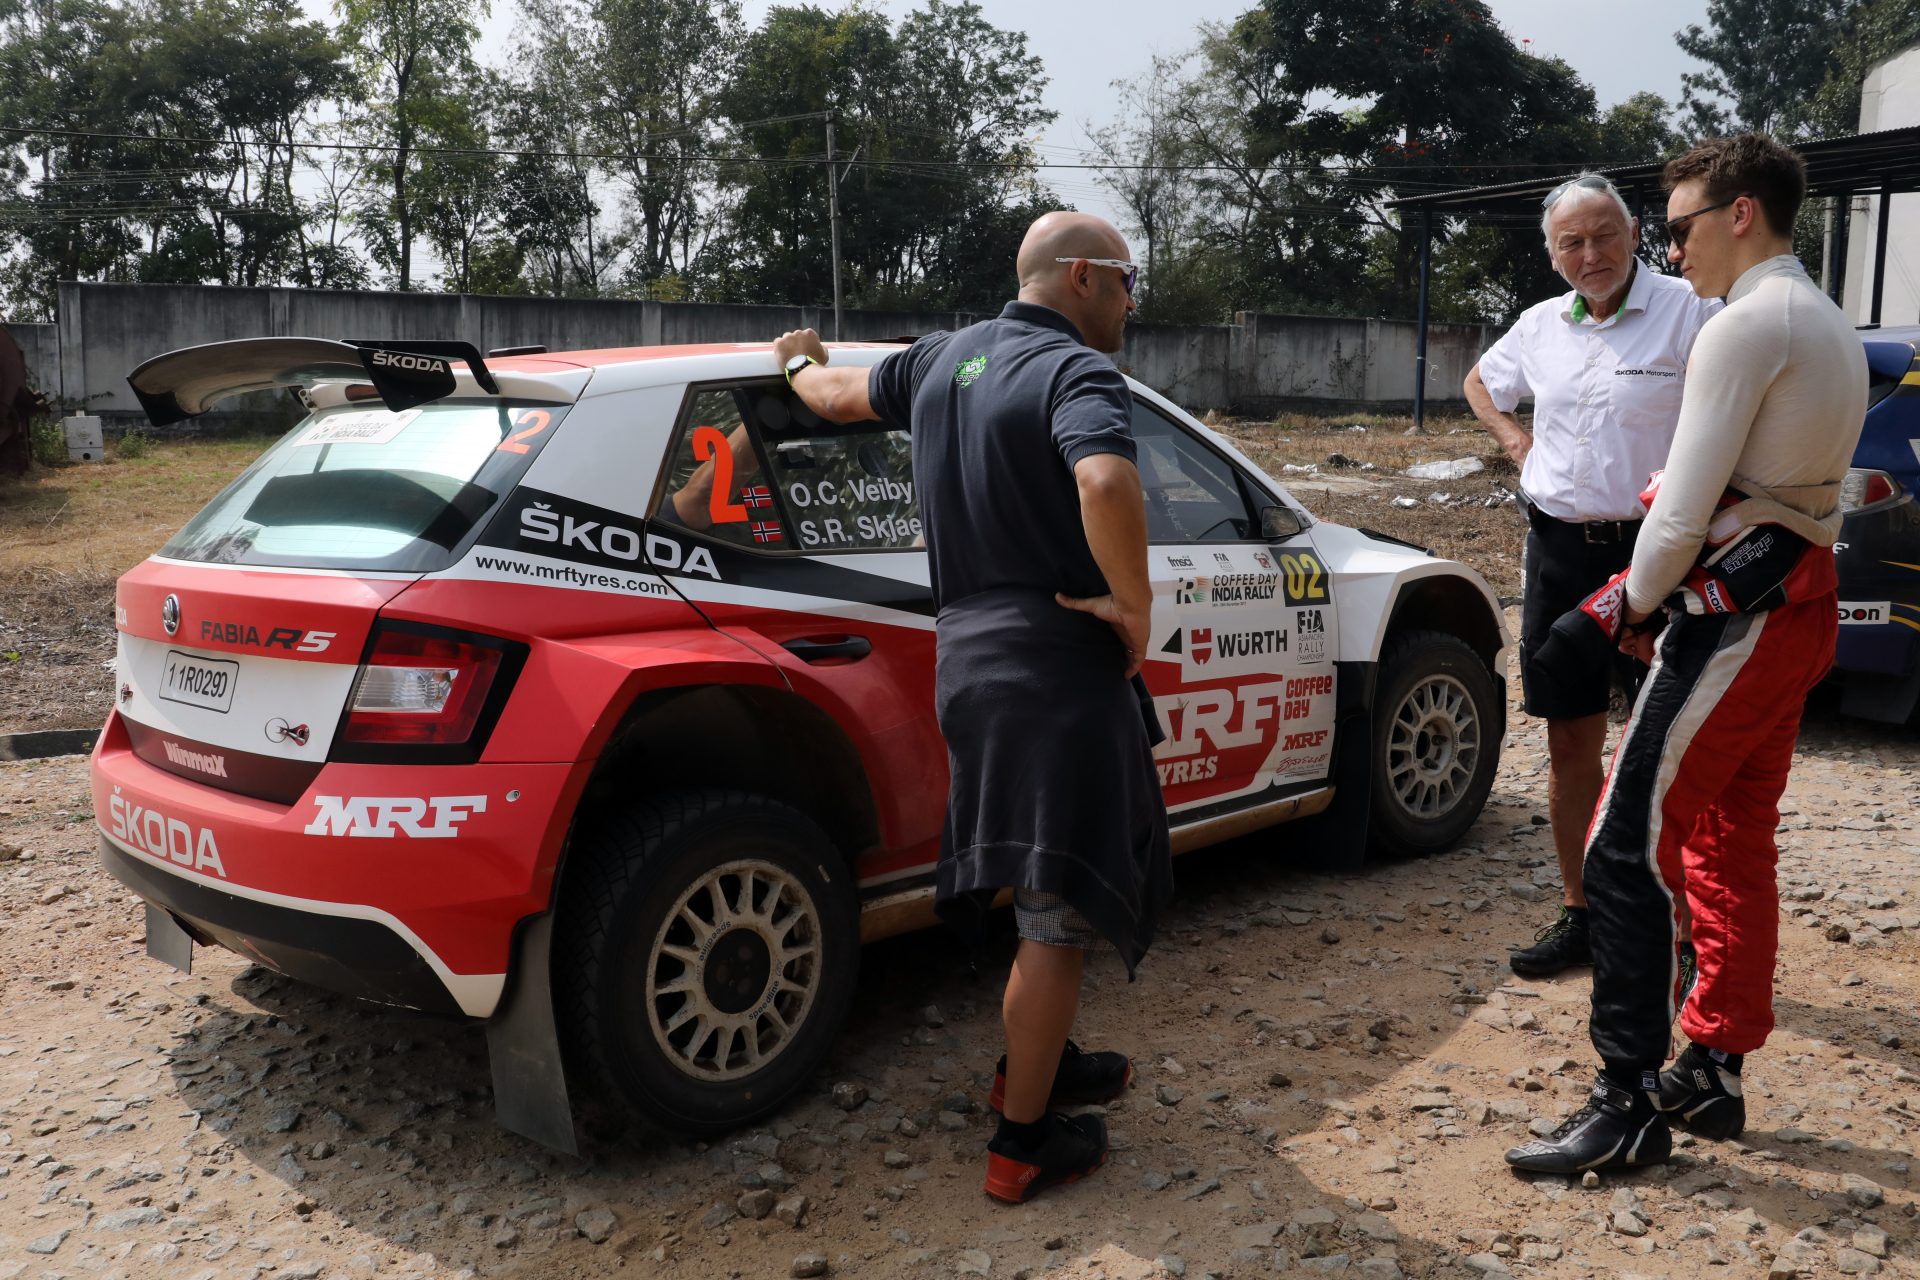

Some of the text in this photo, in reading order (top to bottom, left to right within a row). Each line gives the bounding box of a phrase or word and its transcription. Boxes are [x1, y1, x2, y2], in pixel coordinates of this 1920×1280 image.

[373, 350, 445, 373] ŠKODA
[1645, 370, 1677, 378] Motorsport
[497, 410, 551, 455] 2
[692, 426, 748, 523] 2
[790, 478, 912, 507] O.C. Veiby
[519, 502, 723, 580] ŠKODA
[800, 519, 853, 545] S.R.
[475, 555, 669, 596] www.mrftyres.com
[1213, 573, 1279, 587] COFFEE DAY
[1279, 553, 1325, 600] 02
[1211, 585, 1276, 602] INDIA RALLY
[1705, 582, 1725, 613] ŠKOD
[201, 620, 338, 653] FABIA R5
[1298, 641, 1324, 654] RALLY
[1281, 729, 1328, 752] MRF
[1156, 755, 1219, 786] YRES
[109, 784, 227, 878] ŠKODA
[303, 794, 488, 839] MRF
[748, 979, 780, 1021] speedline
[1693, 1068, 1712, 1091] OMP
